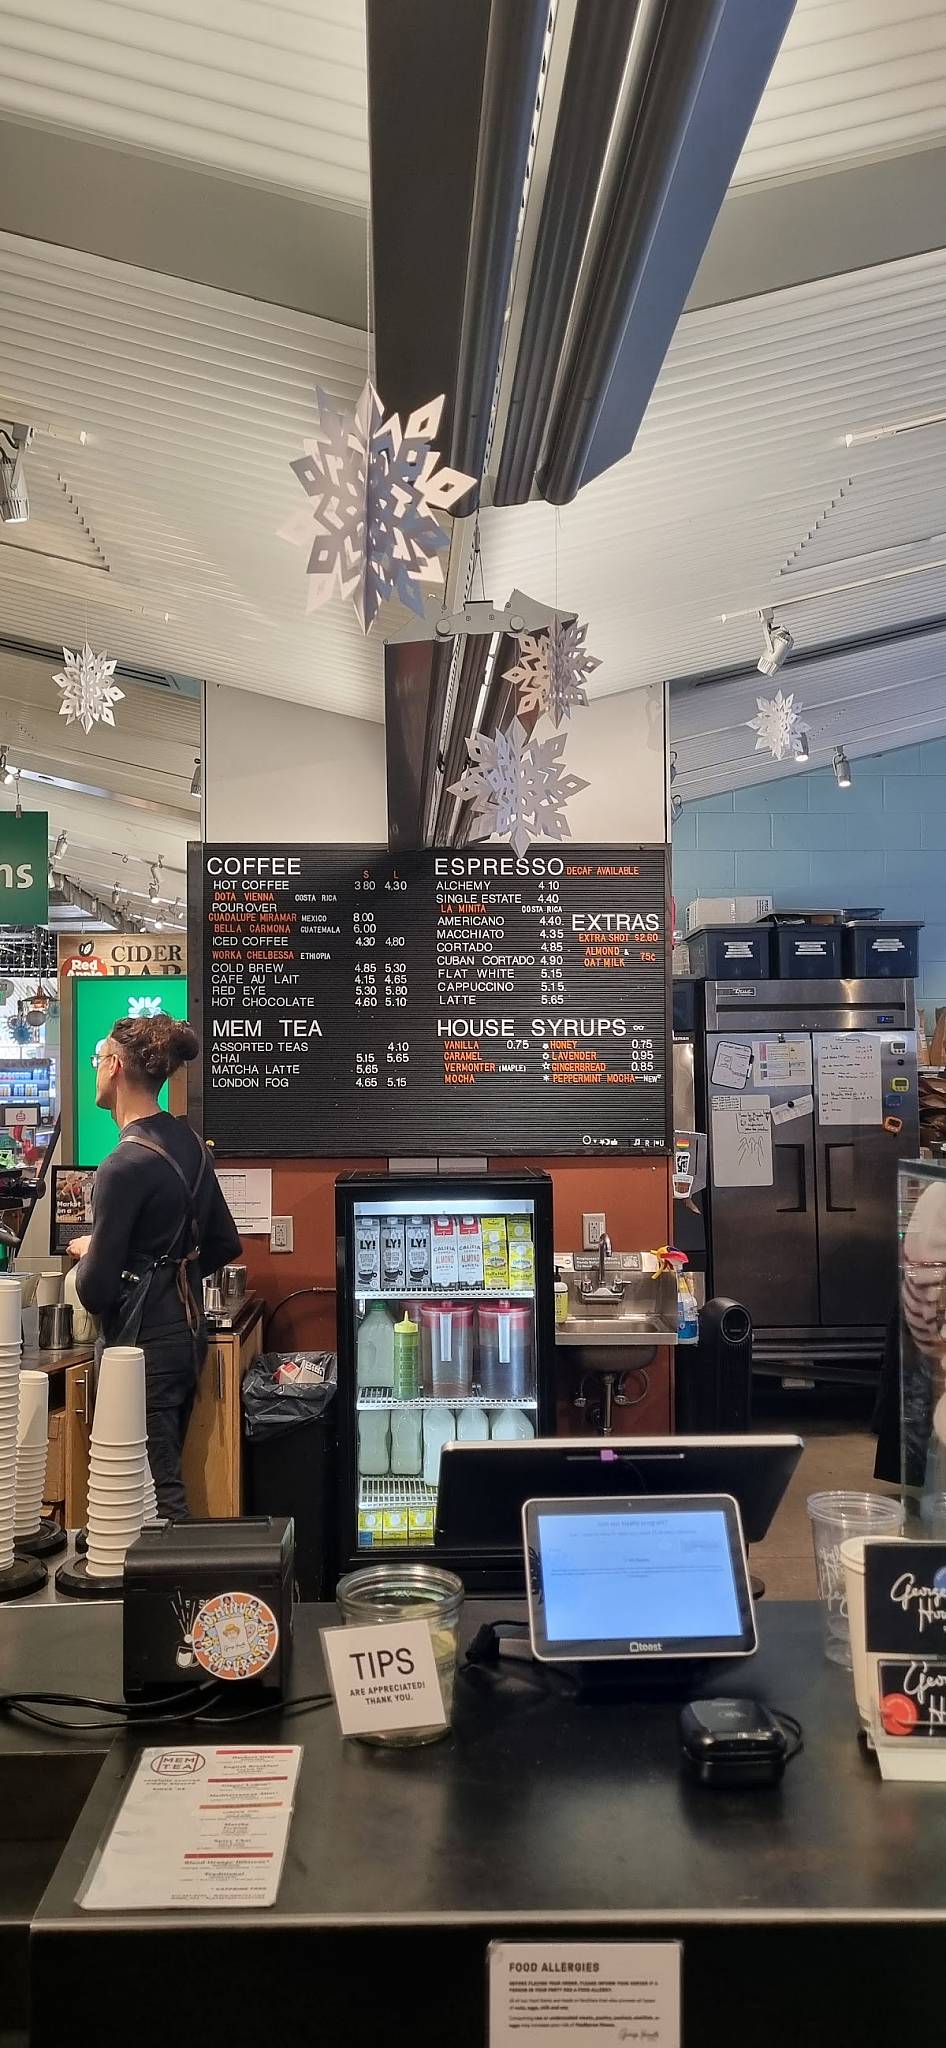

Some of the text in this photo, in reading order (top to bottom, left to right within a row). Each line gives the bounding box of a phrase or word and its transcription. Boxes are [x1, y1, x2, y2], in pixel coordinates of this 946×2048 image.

[207, 857, 301, 875] COFFEE
[434, 858, 639, 876] ESPRESSO DECAF AVAILABLE
[363, 870, 399, 879] S L
[214, 880, 237, 890] HOT
[242, 880, 289, 890] COFFEE
[384, 881, 407, 890] 4.30
[436, 881, 491, 891] ALCHEMY
[214, 892, 337, 902] DOTA VIENNA COSTA RICA
[436, 894, 559, 904] SINGLE ESTATE 4.40
[441, 904, 453, 913] LA
[459, 904, 486, 913] MINITA
[208, 913, 256, 922] GUADALUPE
[260, 913, 297, 922] MIRAMAR
[353, 913, 374, 922] 8.00
[437, 916, 504, 926] AMERICANO
[571, 914, 659, 931] EXTRAS
[214, 924, 241, 933] BELLA
[250, 924, 290, 933] CARMONA
[353, 924, 376, 933] 6.00
[437, 929, 563, 939] MACCHIATO 4.35
[579, 934, 658, 942] EXTRA SHOT $2.60
[212, 936, 405, 946] ICED COFFEE 4.30 4.80
[437, 943, 563, 952] CORTADO 4.85
[586, 947, 620, 956] ALMOND
[111, 945, 182, 963] CIDER
[212, 951, 330, 960] WORKA CHELBESSA ETHIOPIA
[71, 960, 98, 971] Red
[437, 956, 563, 965] CUBAN CORTADO 4.90
[584, 959, 625, 967] OAT MILK
[211, 964, 406, 973] COLD BREW 4.85 5.30
[438, 969, 562, 979] FLAT WHITE 5.15
[211, 975, 407, 984] CAFE AU LAIT 4.15 4.65
[212, 986, 407, 995] RED EYE 5.30 5.80
[438, 982, 514, 991] CAPPUCCINO
[211, 997, 406, 1007] HOT CHOCOLATE 4.60 5.10
[439, 995, 564, 1005] LATTE 5.65
[212, 1020, 323, 1037] MEM TEA
[438, 1019, 627, 1037] HOUSE SYRUPS
[212, 1042, 409, 1051] ASSORTED TEAS 4.10
[444, 1040, 529, 1049] VANILLA 0.75
[550, 1040, 652, 1049] HONEY 0.75
[212, 1054, 409, 1063] CHAI 5.15 5.65
[444, 1052, 482, 1061] CARAMEL
[552, 1051, 653, 1061] LAVENDER 0.95
[212, 1065, 378, 1074] MATCHA LATTE 5.65
[444, 1063, 495, 1072] VERMONTER
[552, 1062, 653, 1072] GINGERBREAD 0.85
[212, 1078, 407, 1088] LONDON FOG 4.65 5.15
[444, 1074, 475, 1084] MOCHA
[552, 1074, 602, 1084] PEPPERMINT
[607, 1074, 635, 1083] MOCHA
[360, 1240, 376, 1250] LY!
[385, 1238, 401, 1249] LY!
[410, 1238, 427, 1248] LY!
[349, 1647, 415, 1680] TIPS
[349, 1681, 425, 1697] ARE APPRECIATED!
[365, 1693, 413, 1705] THANK YOU.
[509, 1962, 600, 1972] FOOD ALLERGIES
